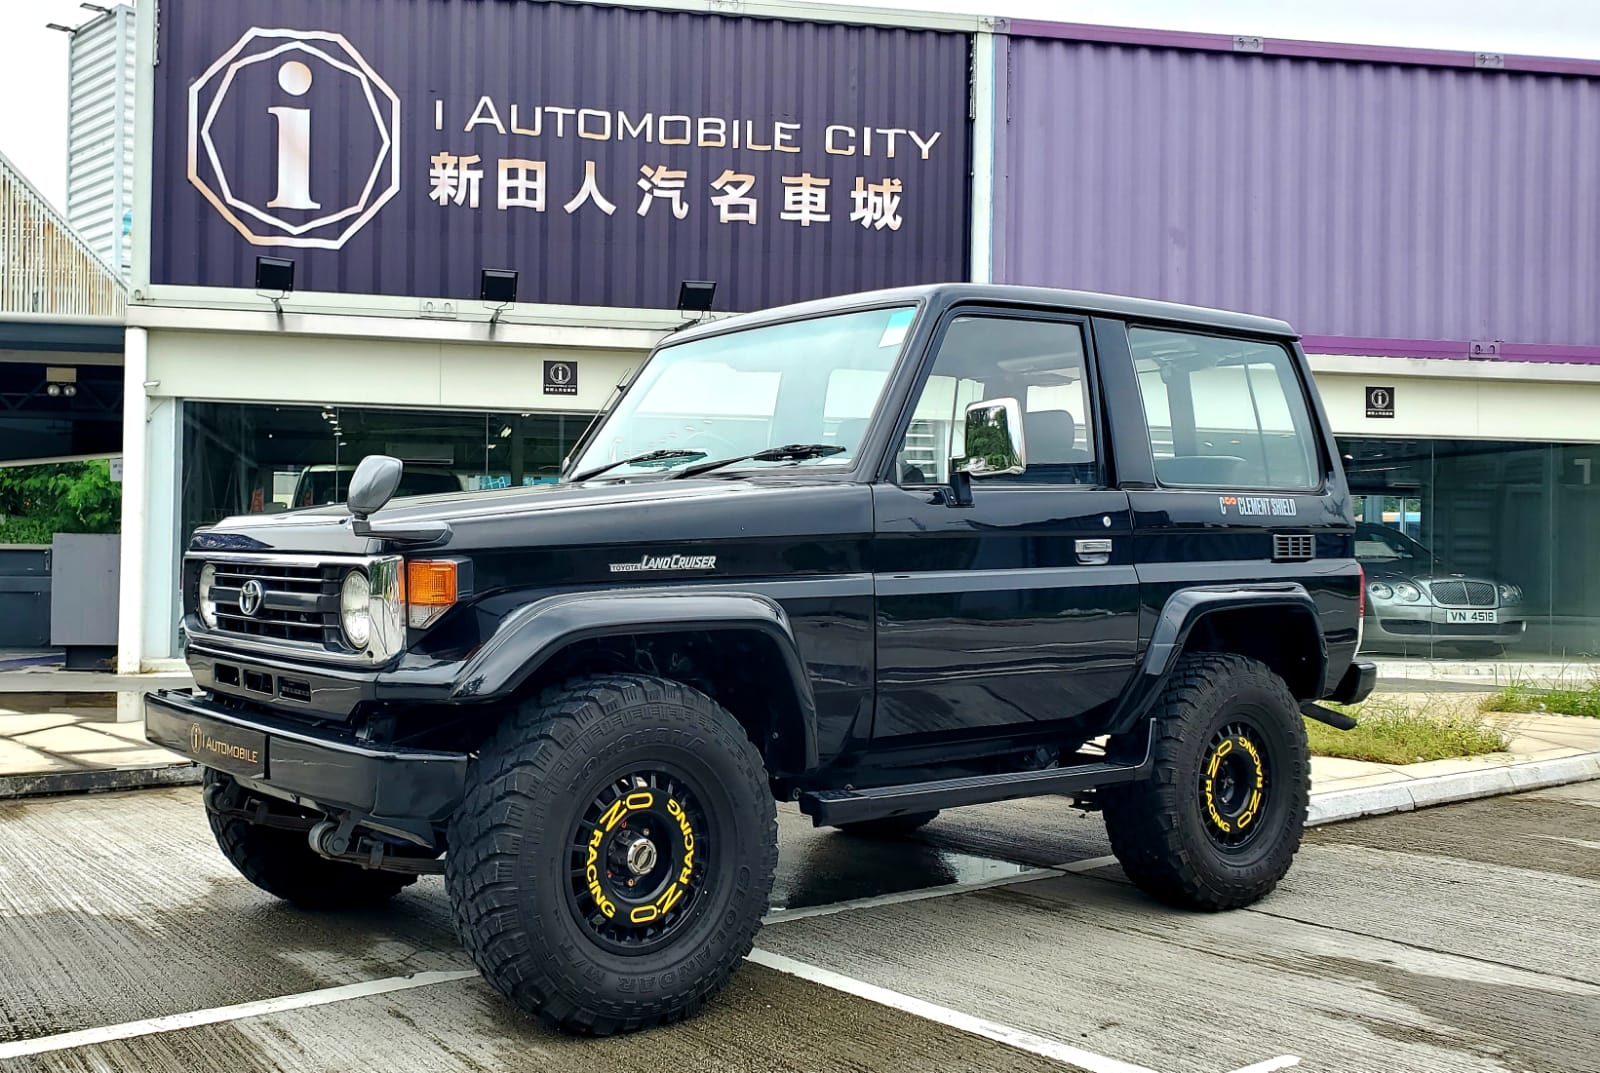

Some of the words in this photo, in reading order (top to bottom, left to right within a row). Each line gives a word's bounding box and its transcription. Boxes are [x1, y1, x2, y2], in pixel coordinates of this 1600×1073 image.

[435, 99, 443, 130] I
[464, 95, 801, 153] AUTOMOBILE
[825, 125, 941, 160] CITY
[428, 151, 903, 231] 新田人汽名車城
[1238, 496, 1271, 516] CLEMENT
[1271, 498, 1297, 516] SHIELD
[610, 563, 641, 572] TOYOTA
[1450, 611, 1466, 621] VN
[1471, 611, 1495, 622] 4518
[206, 736, 258, 764] AUTOMOBILE
[1238, 736, 1264, 788] RACING
[1205, 779, 1231, 832] RACING
[667, 798, 695, 885] RACING
[587, 829, 616, 919] RACING
